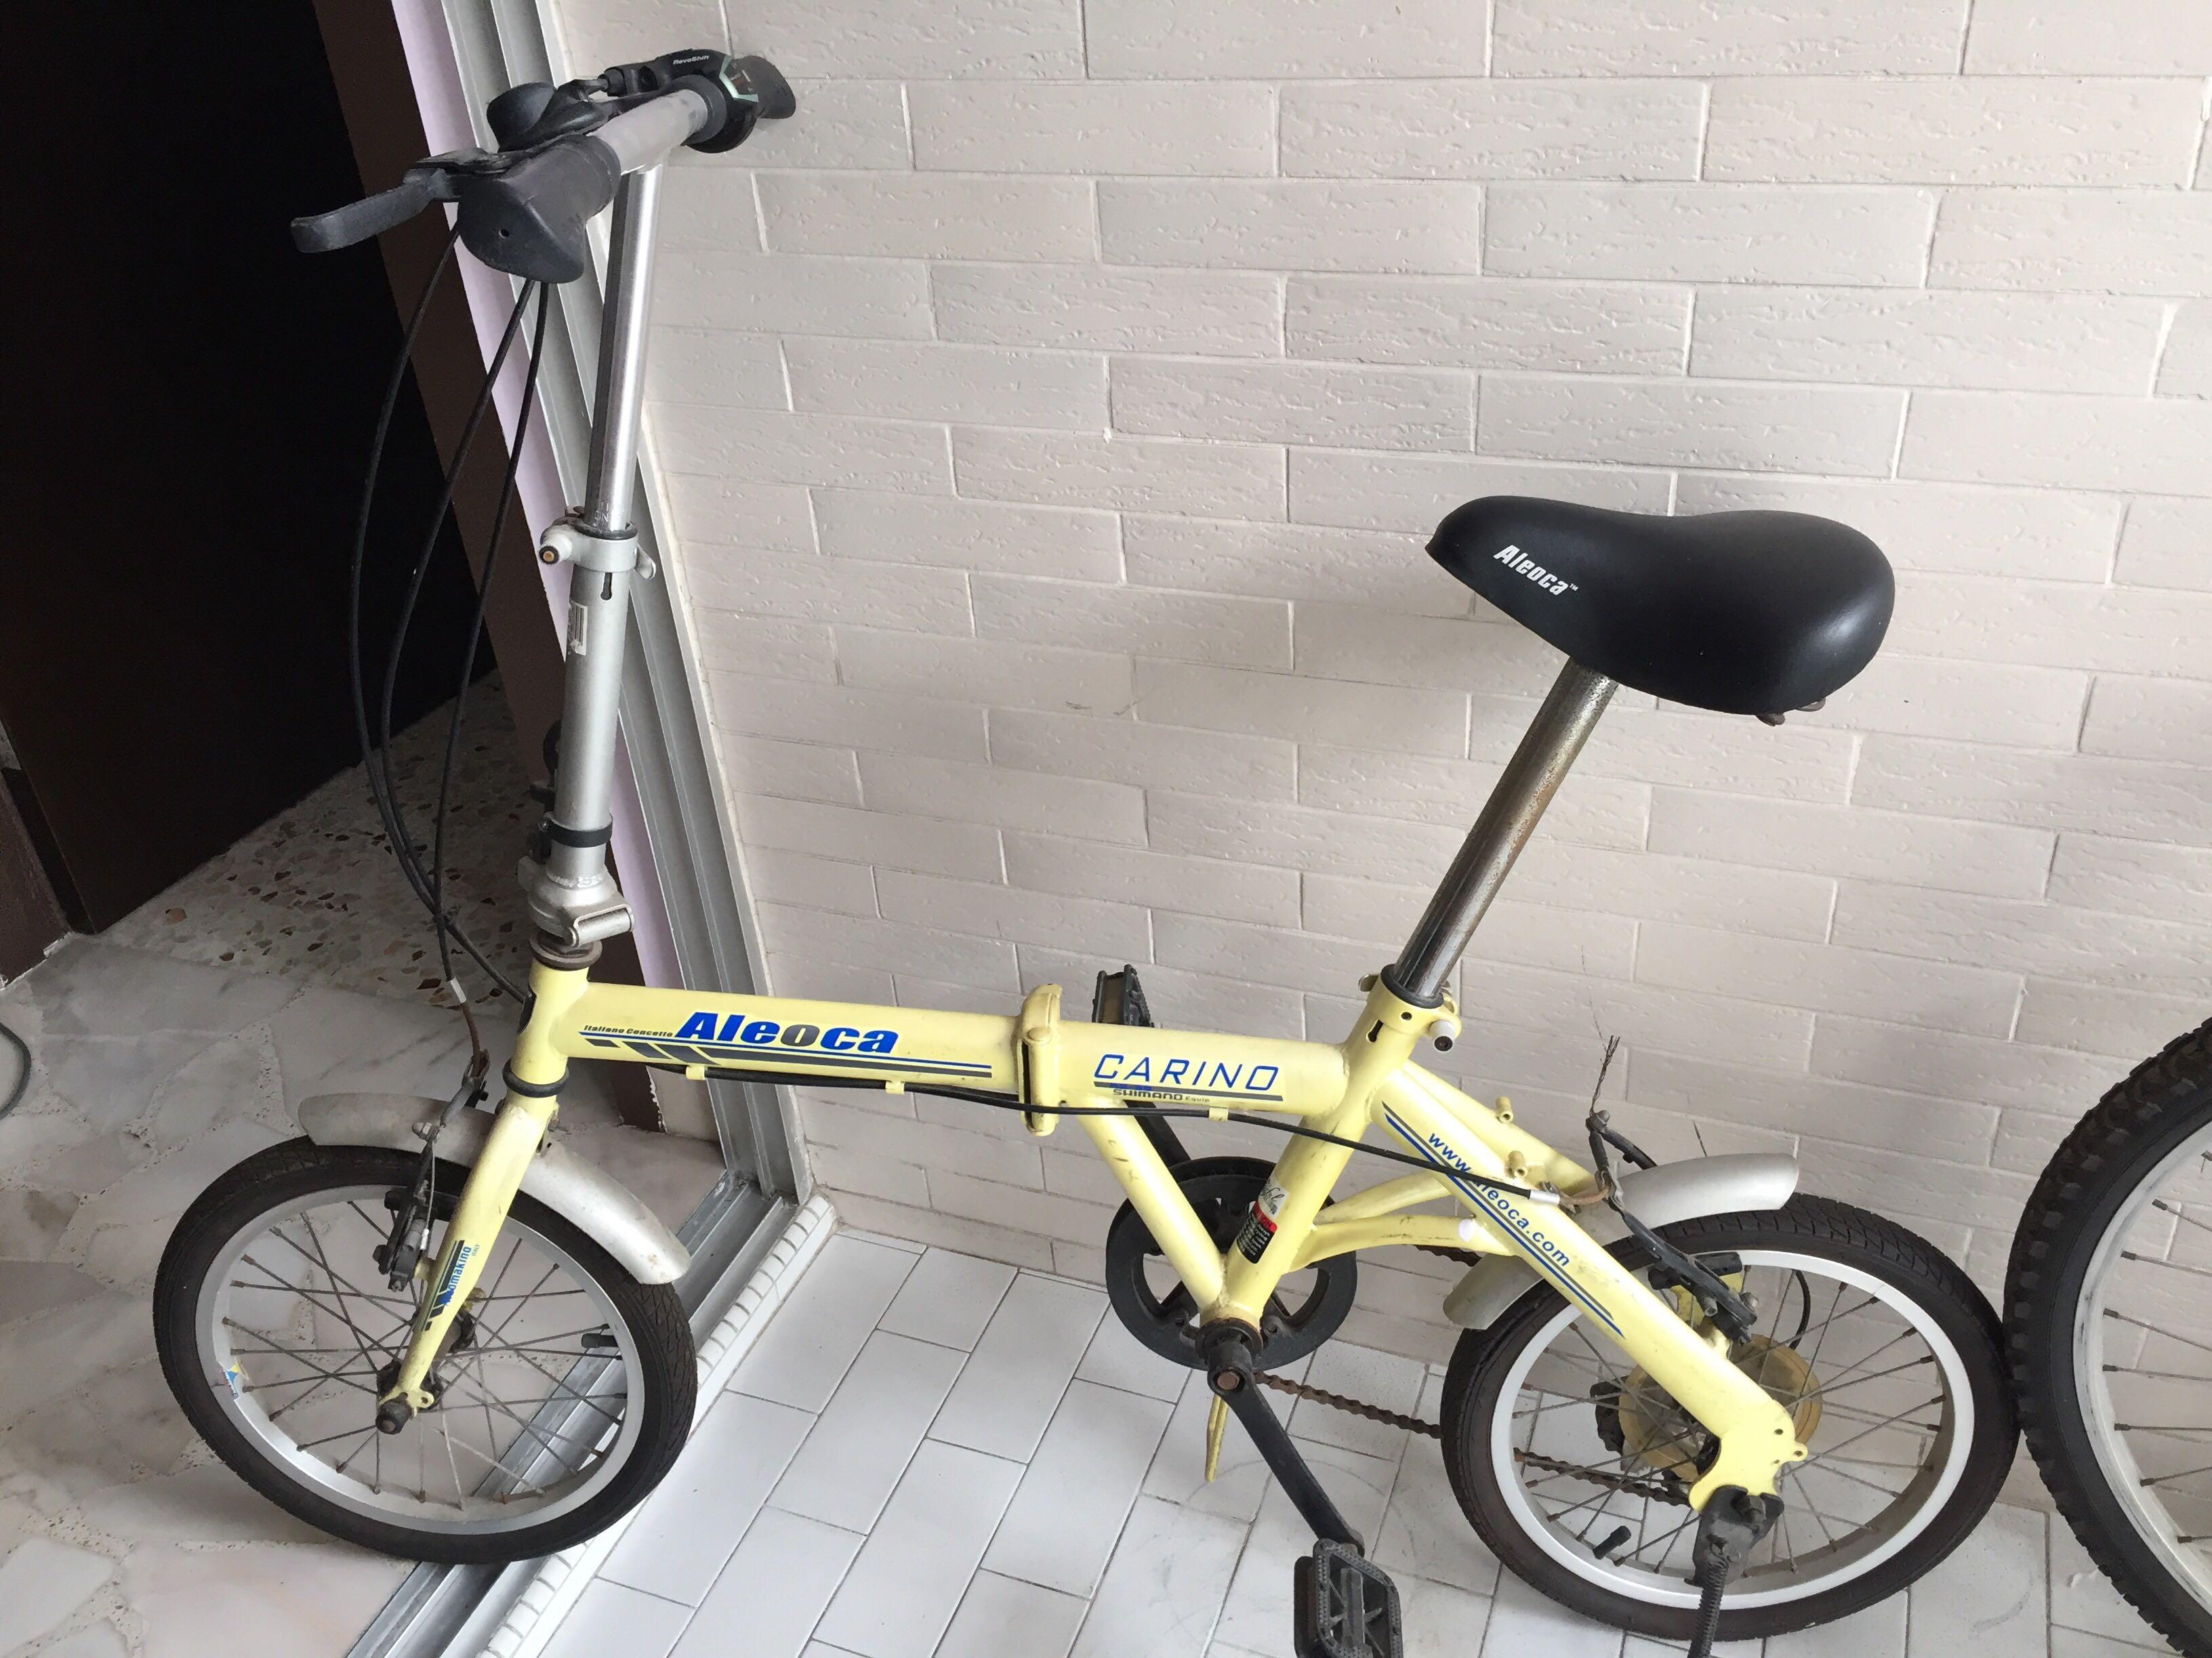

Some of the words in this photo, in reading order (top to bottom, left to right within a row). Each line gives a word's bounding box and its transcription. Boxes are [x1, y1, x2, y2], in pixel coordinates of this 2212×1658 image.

[672, 55, 710, 65] RevoShift
[674, 1012, 899, 1054] Aleoca
[1094, 1054, 1279, 1091] CARINO
[1113, 1089, 1183, 1100] SHIMANO
[1185, 1095, 1210, 1103] Equip
[1429, 1133, 1570, 1267] wwweoca.com
